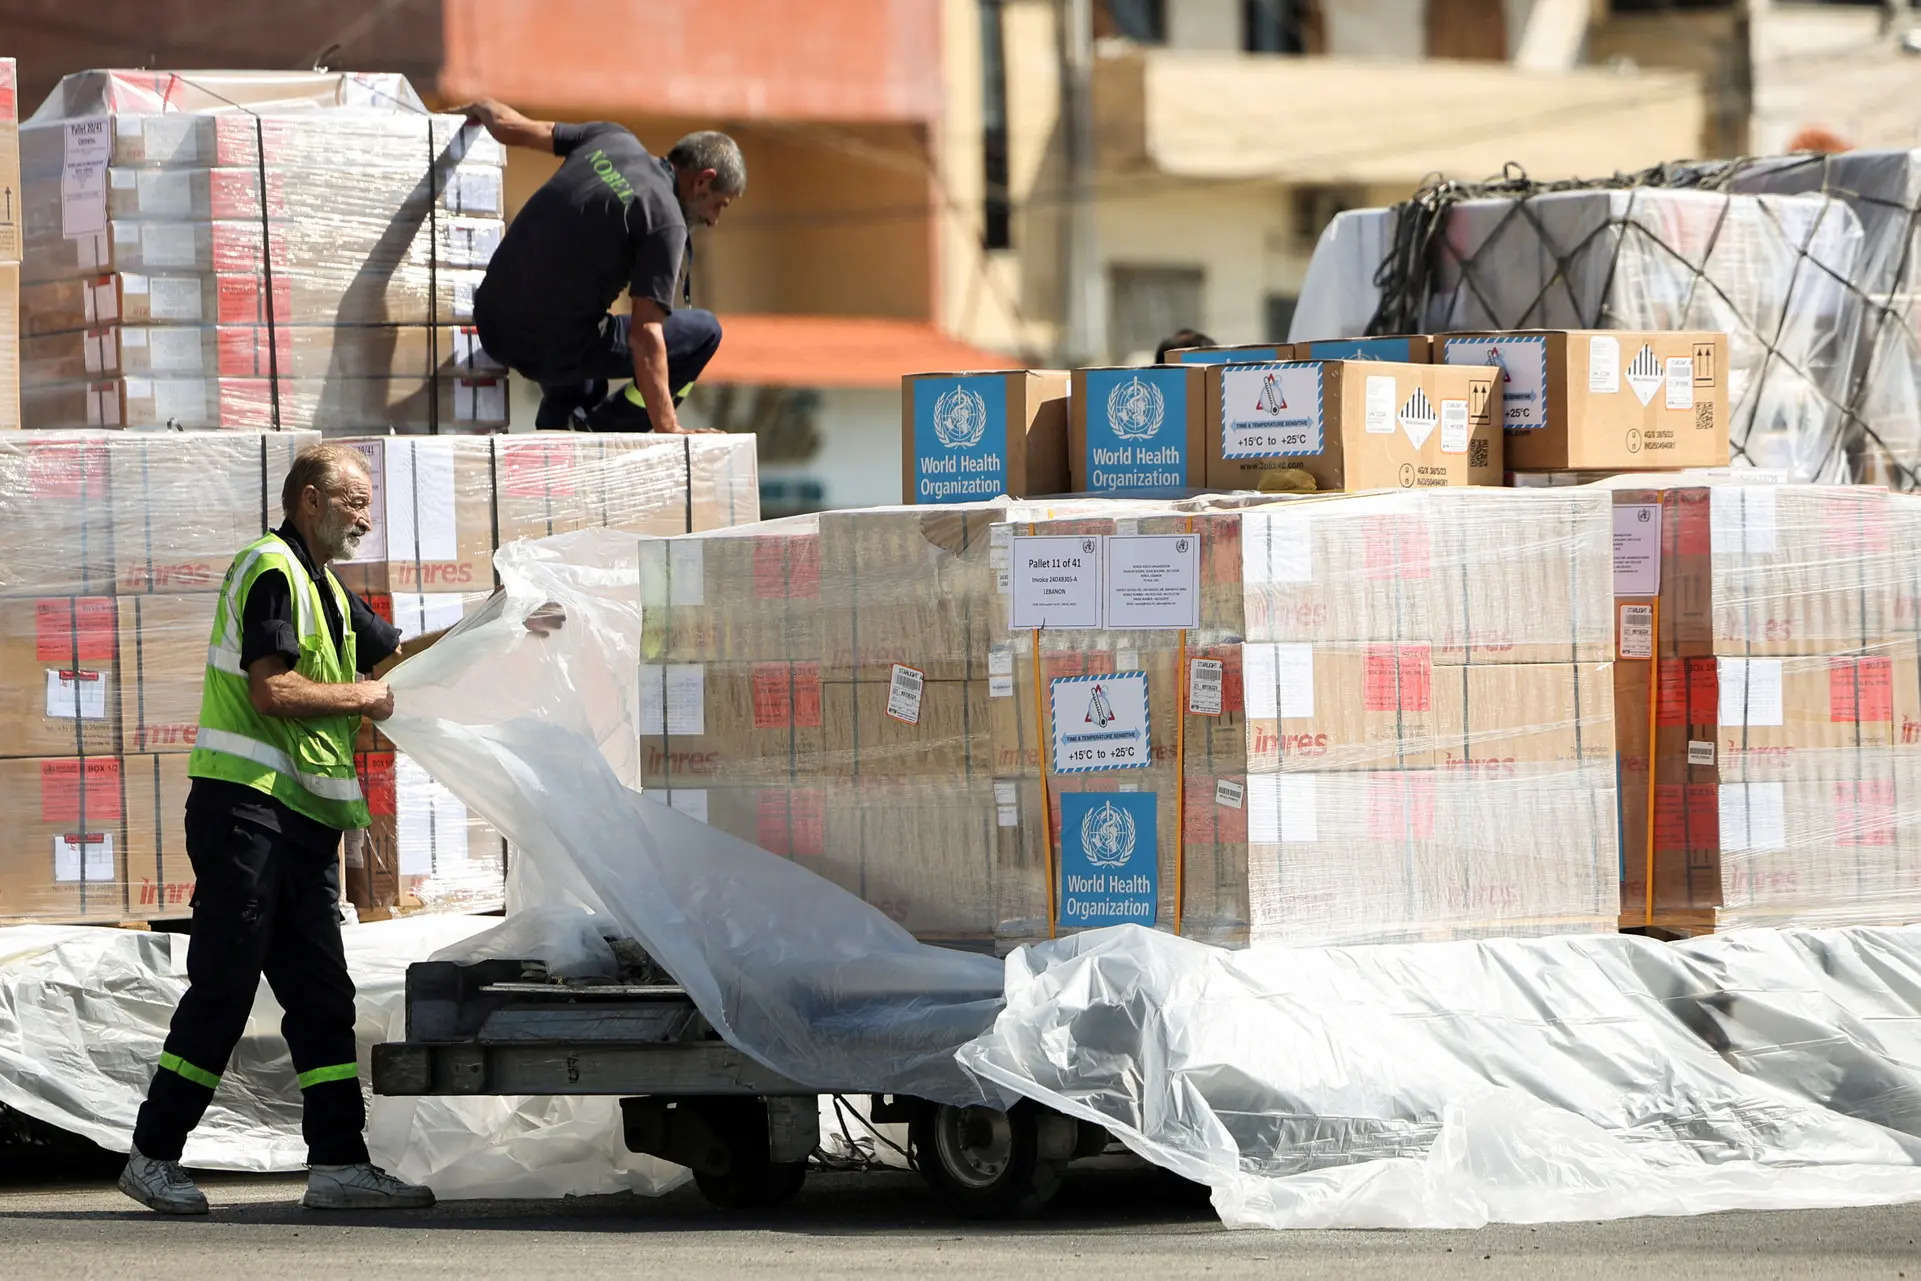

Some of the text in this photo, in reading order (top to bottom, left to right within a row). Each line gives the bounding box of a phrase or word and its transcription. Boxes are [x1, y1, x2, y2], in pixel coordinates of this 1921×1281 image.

[1238, 434, 1306, 447] +15°C to +25°C
[920, 453, 1000, 474] World Health
[1093, 446, 1180, 466] World Health
[920, 476, 1000, 499] Organization
[1093, 469, 1180, 491] Organization
[126, 561, 210, 586] imres
[399, 560, 473, 585] imres
[1028, 557, 1081, 569] Pallet 11 of 41
[133, 723, 200, 746] imre
[1254, 725, 1330, 756] imres
[648, 744, 721, 776] imres
[1069, 746, 1135, 760] +15°C to +25°C
[1068, 874, 1150, 894] World Health
[1067, 897, 1150, 920] Organization
